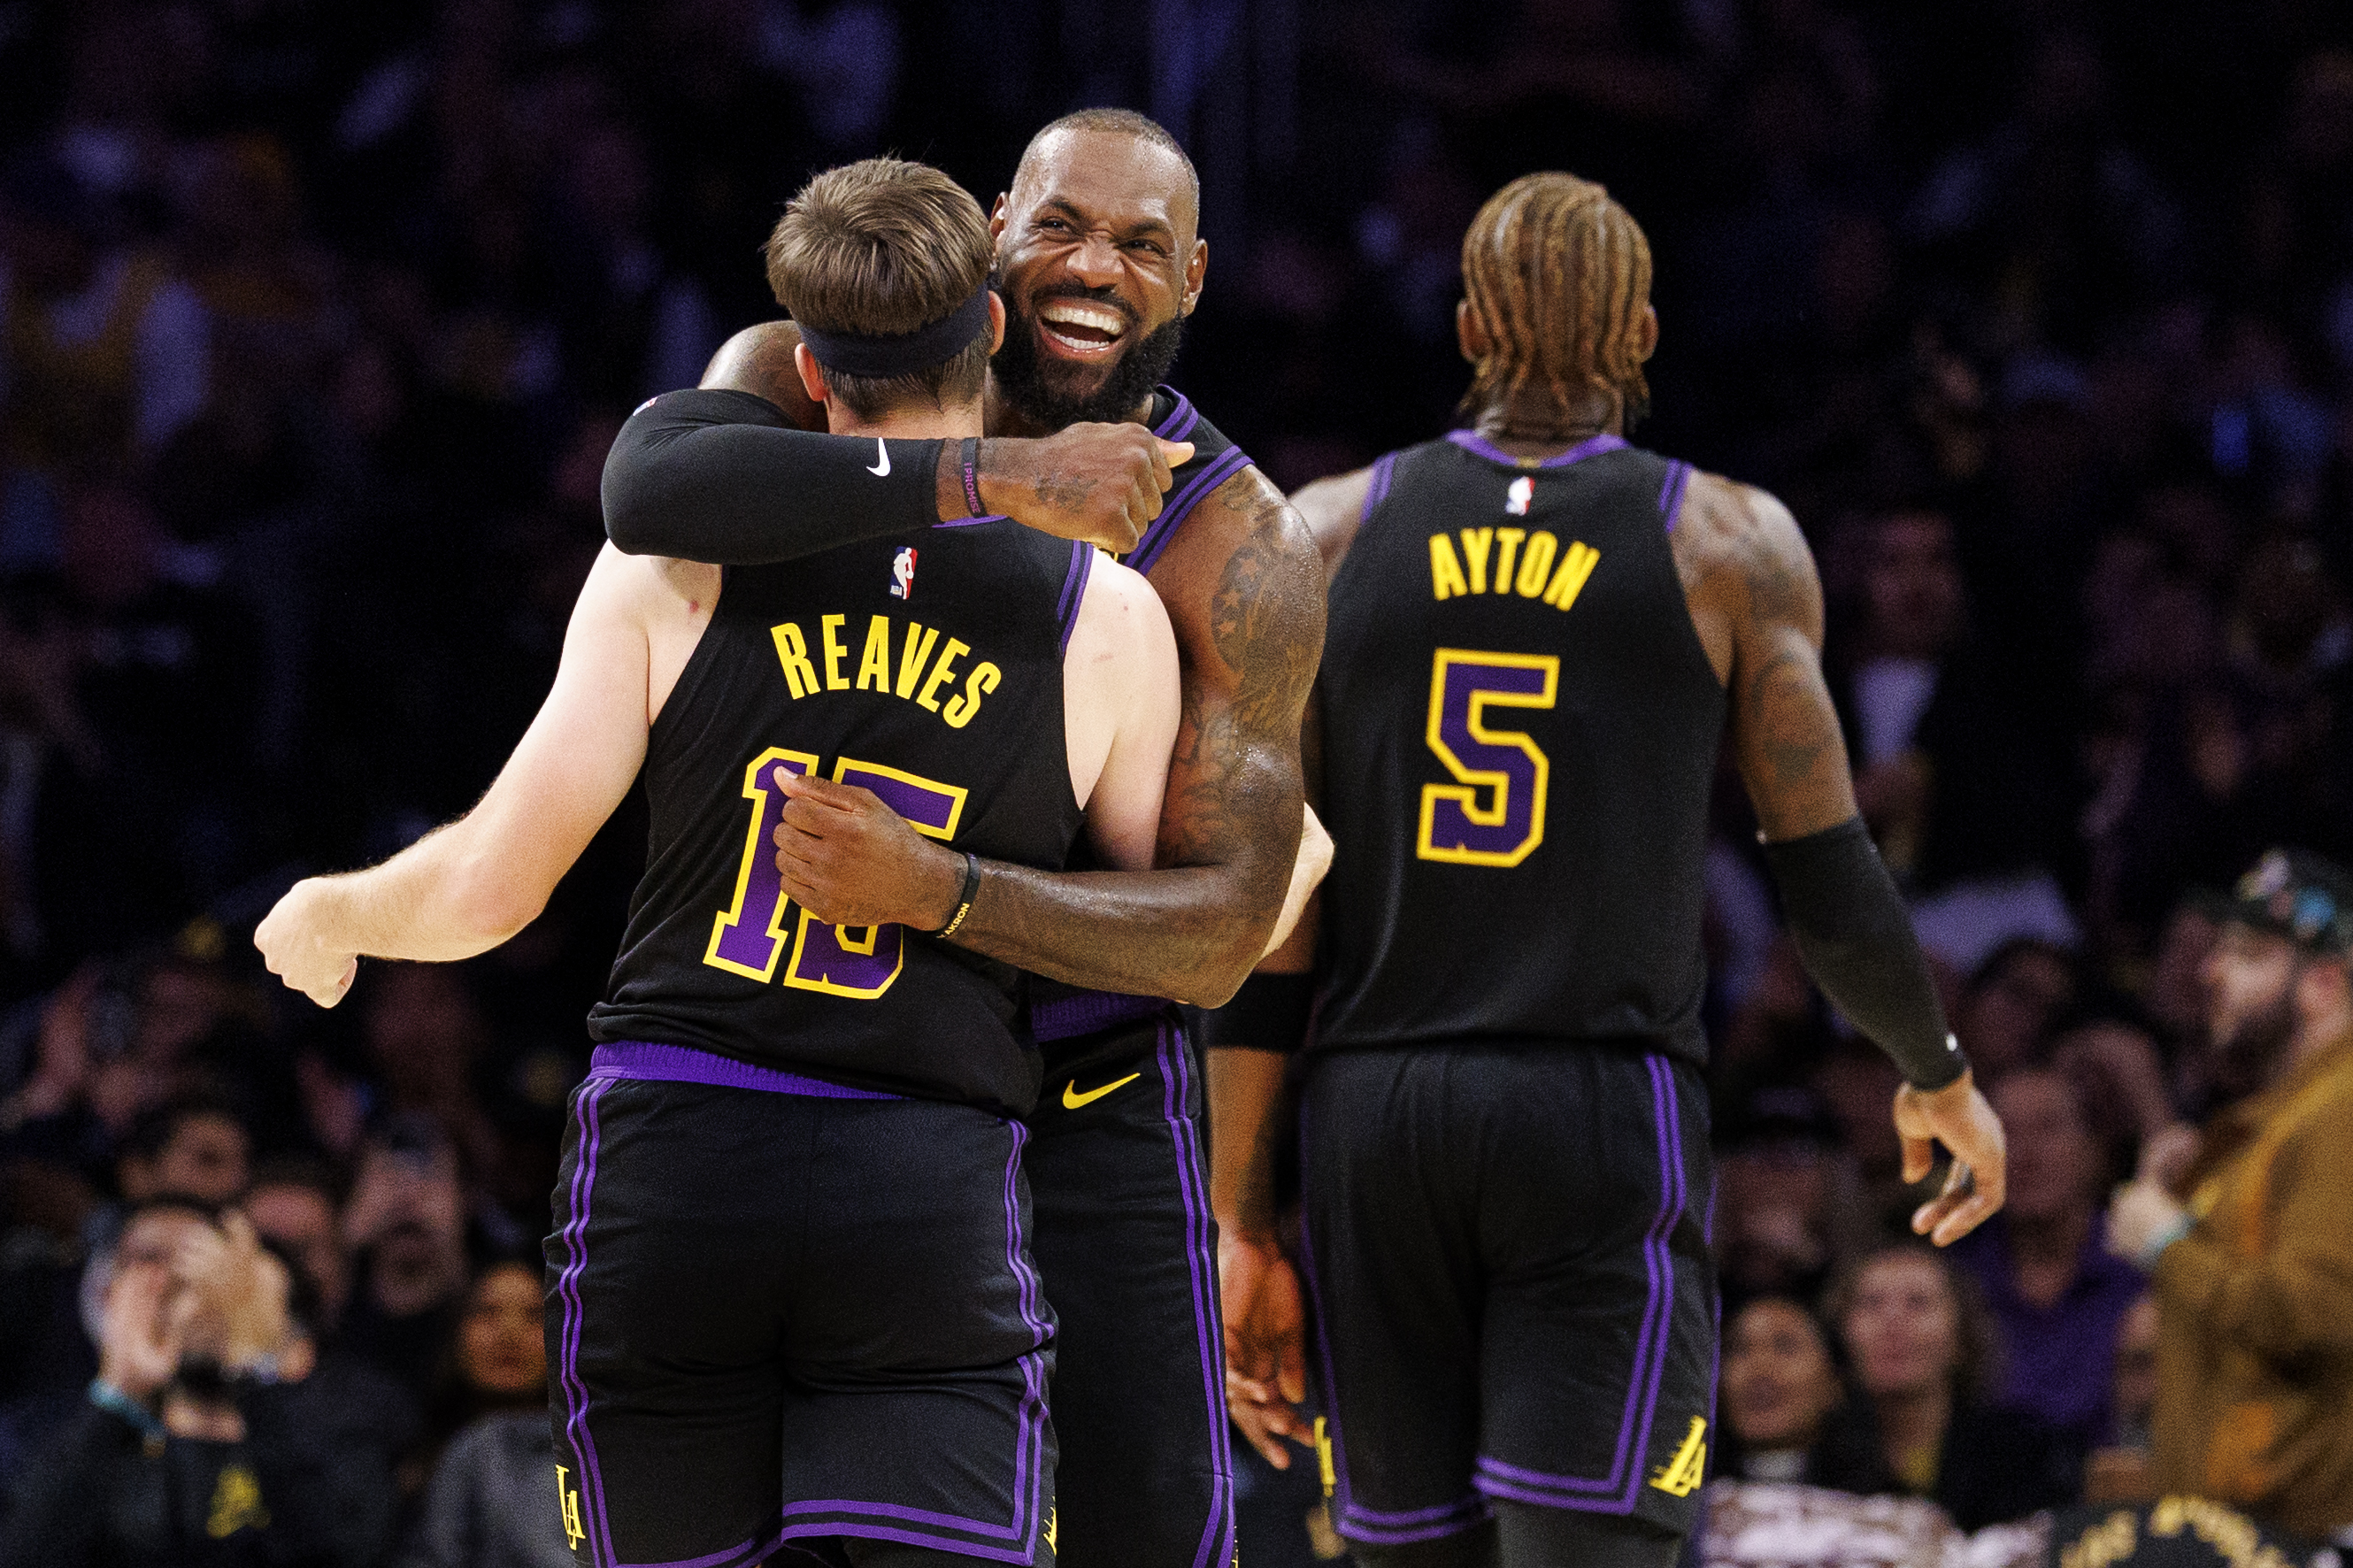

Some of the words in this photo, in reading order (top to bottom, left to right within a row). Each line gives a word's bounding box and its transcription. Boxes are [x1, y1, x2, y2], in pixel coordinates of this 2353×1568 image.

[1428, 527, 1601, 611] AYTON
[771, 614, 1002, 729] REAVES
[1417, 647, 1561, 868] 5
[944, 903, 970, 935] AKRON
